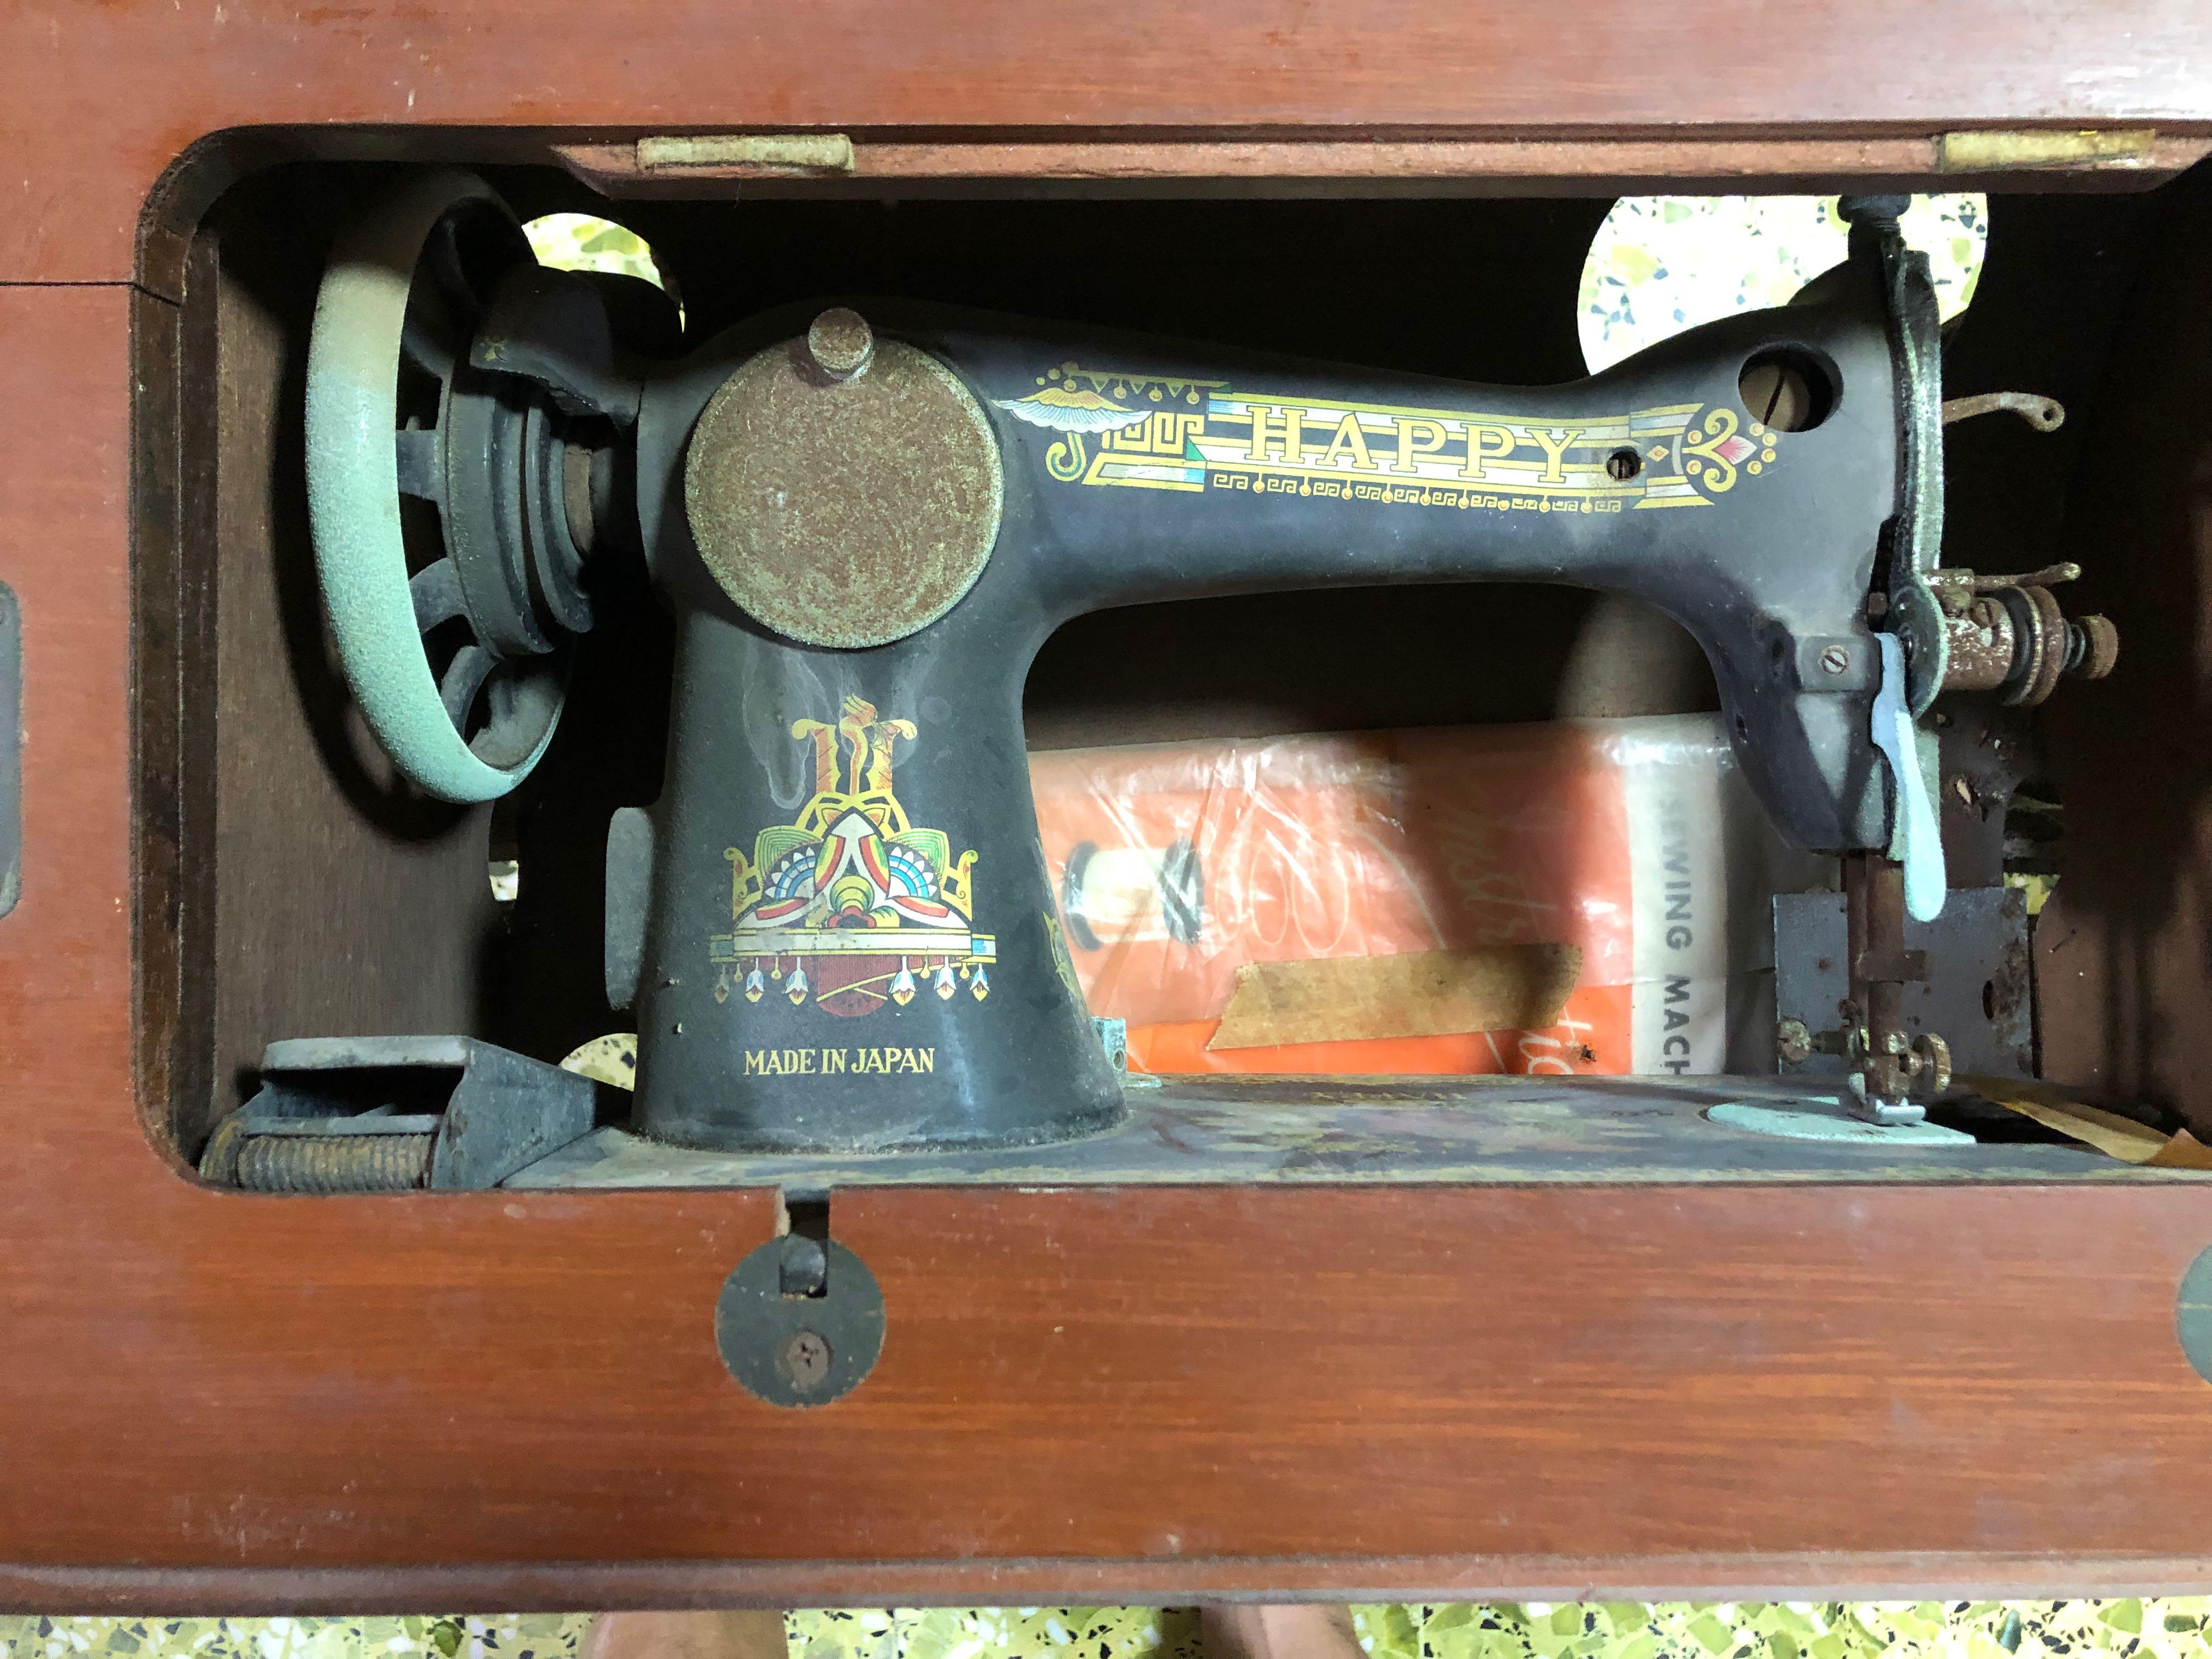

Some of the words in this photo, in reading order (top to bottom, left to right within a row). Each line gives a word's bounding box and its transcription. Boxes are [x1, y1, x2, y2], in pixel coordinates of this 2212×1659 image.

[1244, 405, 1586, 484] HAPPY
[1661, 797, 1694, 951] WING
[742, 1048, 816, 1076] MADE
[820, 1048, 848, 1075] IN
[851, 1047, 936, 1074] JAPAN
